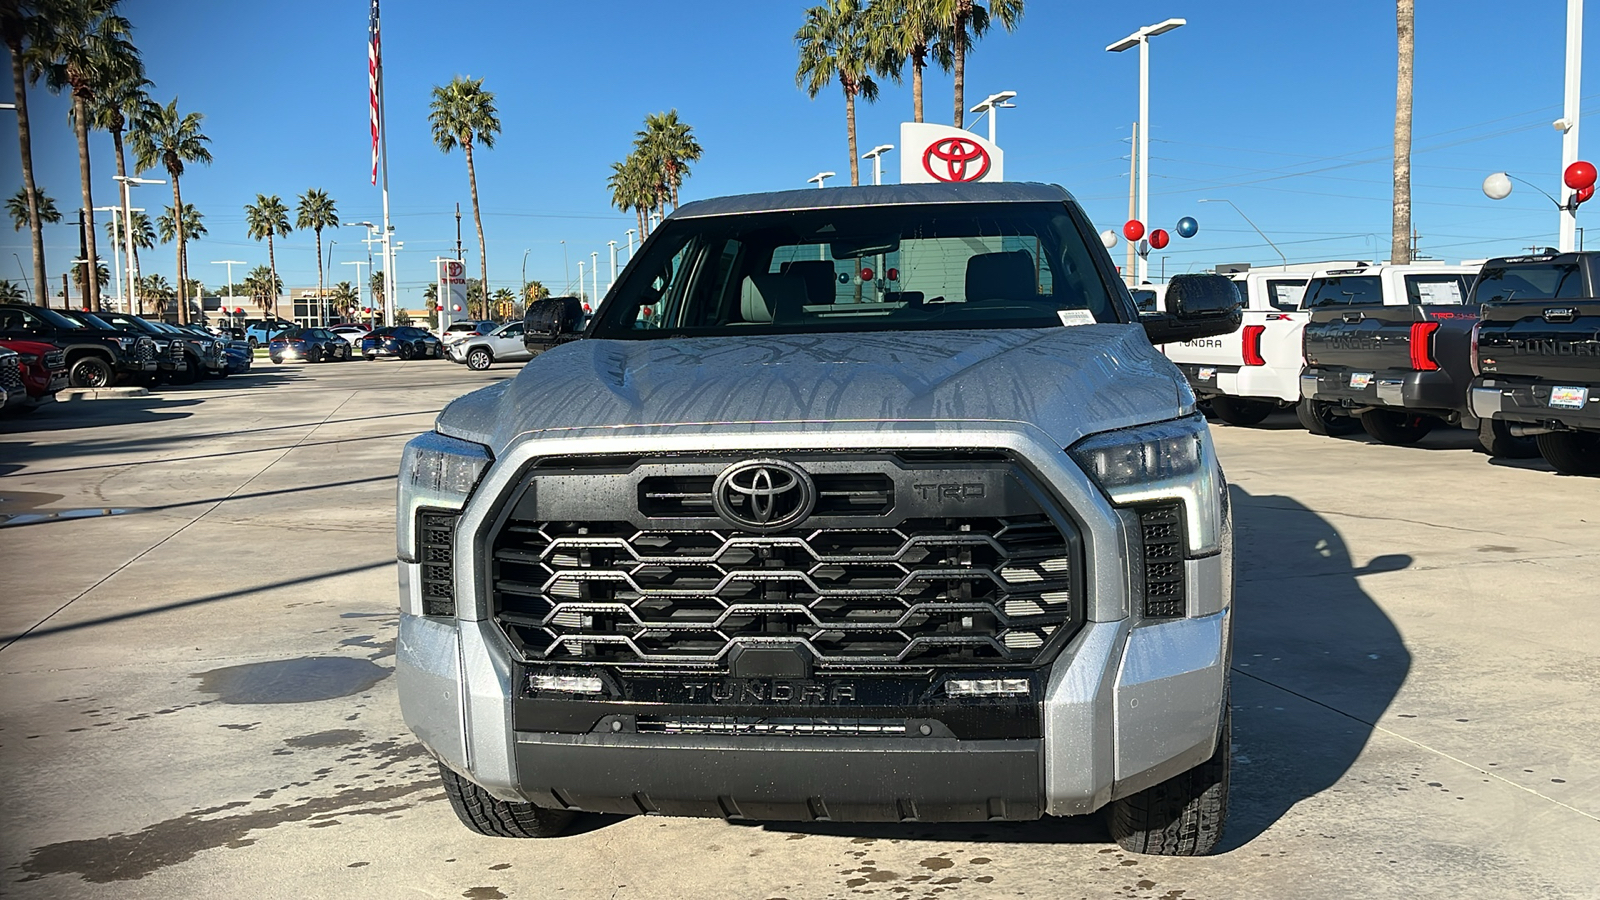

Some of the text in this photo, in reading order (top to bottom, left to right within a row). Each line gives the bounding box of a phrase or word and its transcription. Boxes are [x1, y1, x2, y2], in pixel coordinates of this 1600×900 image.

[1429, 312, 1454, 320] TRD
[1323, 337, 1382, 350] TUNDRA
[1510, 339, 1600, 356] TUNDR
[913, 483, 986, 503] TRD
[682, 681, 856, 701] TUNDRA
